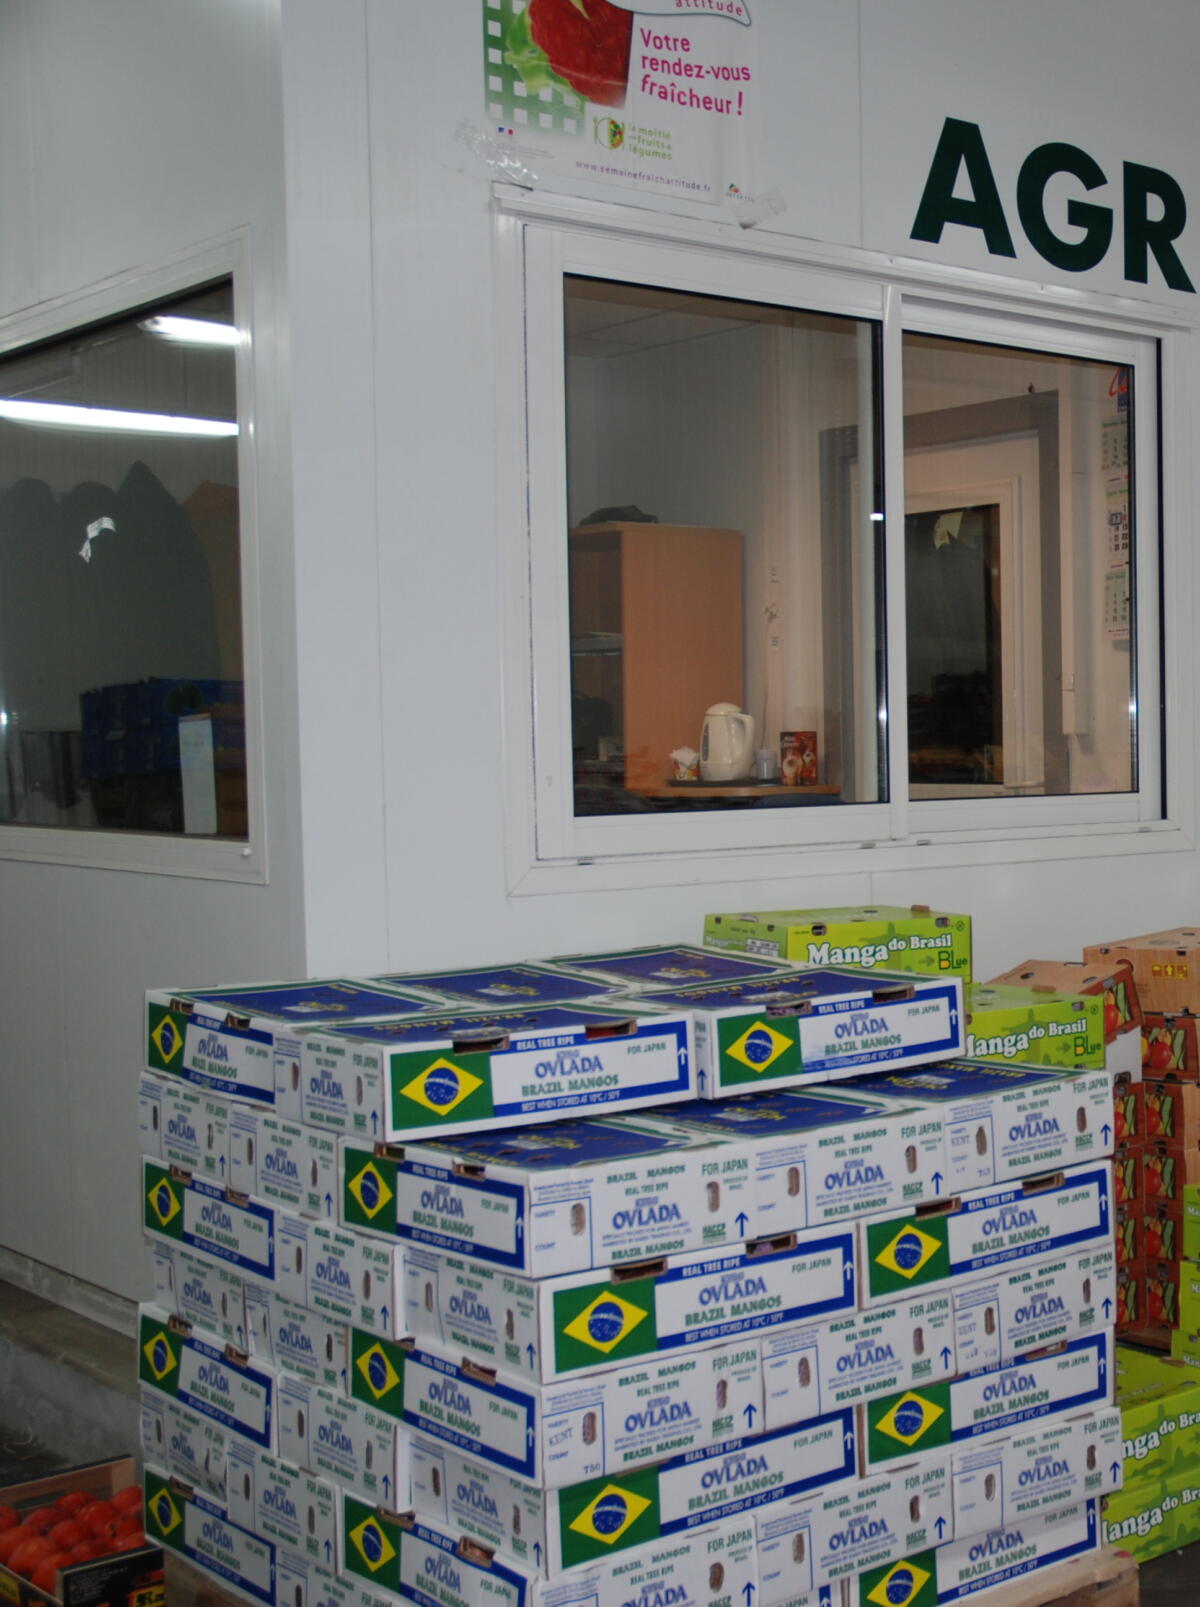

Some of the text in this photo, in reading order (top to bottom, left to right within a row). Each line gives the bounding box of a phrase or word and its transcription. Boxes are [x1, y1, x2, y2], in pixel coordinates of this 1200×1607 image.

[640, 28, 690, 52] Votre
[641, 53, 751, 81] rendez-vous
[628, 143, 673, 161] légumes
[807, 934, 952, 967] Manga do Brasil
[908, 1004, 938, 1016] FOR JAPAN
[834, 1017, 889, 1039] OVLADA
[1028, 1024, 1045, 1040] do
[1048, 1019, 1087, 1036] Brasil
[627, 1042, 665, 1054] FOR JAPAN
[823, 1033, 902, 1057] BRAZIL MANGOS
[534, 1055, 603, 1079] OVLADA
[521, 1073, 619, 1098] BRAZIL MANGOS
[1073, 1077, 1108, 1094] FOR JAPAN
[901, 1122, 942, 1139] FOR JAPAN
[1009, 1117, 1060, 1141] OVLADA
[702, 1159, 748, 1176] FOR JAPAN
[824, 1164, 884, 1190] OVLADA
[612, 1203, 681, 1230] OVLADA
[982, 1209, 1036, 1235] OVLADA
[972, 1227, 1049, 1254] BRAZIL MANGOS
[791, 1257, 831, 1273] FOR JAPAN
[1078, 1253, 1112, 1271] FOR JAPAN
[698, 1276, 766, 1305] OVLADA
[685, 1295, 782, 1327] BRAZIL MANGOS
[910, 1299, 948, 1318] FOR JAPAN
[1015, 1296, 1064, 1323] OVLADA
[713, 1352, 756, 1371] FOR JAPAN
[836, 1343, 894, 1372] OVLADA
[983, 1373, 1036, 1402] OVLADA
[625, 1401, 692, 1432] OVLADA
[972, 1389, 1048, 1421] BRAZIL MANGOS
[1084, 1415, 1120, 1434] FOR JAPAN
[1121, 1428, 1160, 1459] nga
[1159, 1418, 1176, 1435] do
[701, 1454, 767, 1490] OVLADA
[905, 1467, 944, 1489] FOR JAPAN
[1018, 1459, 1070, 1486] OVLADA
[687, 1470, 782, 1512] BRAZIL MANGOS
[1161, 1493, 1179, 1511] do
[707, 1529, 752, 1553] FOR JAPAN
[829, 1518, 888, 1551] OVLADA
[970, 1532, 1023, 1562] OVLADA
[959, 1544, 1035, 1580] BRAZIL MANGOS
